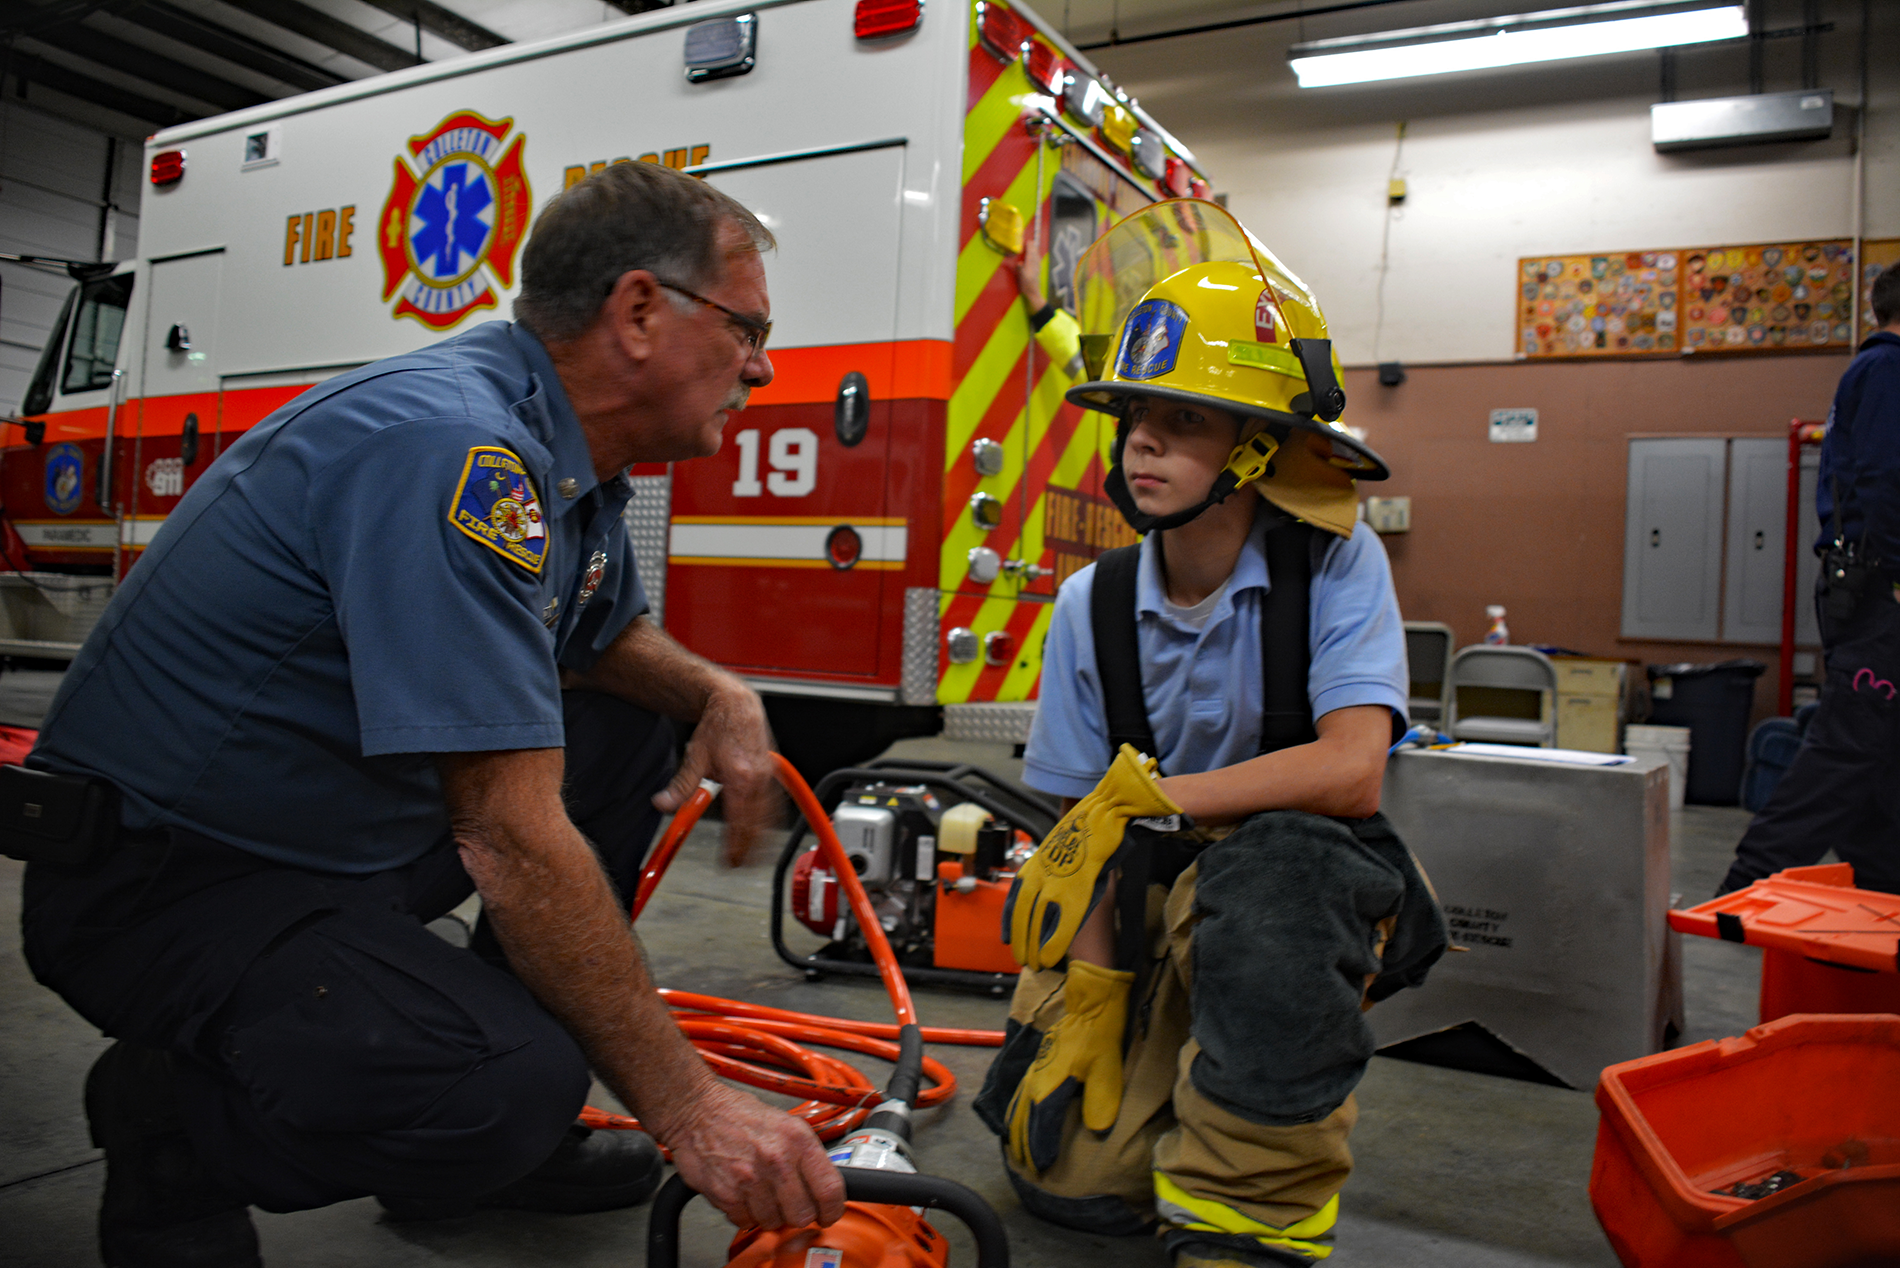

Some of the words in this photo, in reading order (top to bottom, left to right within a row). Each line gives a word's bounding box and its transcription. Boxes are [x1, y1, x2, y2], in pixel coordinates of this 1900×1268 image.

[424, 128, 492, 166] COLLETON
[565, 143, 710, 192] RUE
[283, 204, 356, 267] FIRE
[413, 278, 475, 311] COUNTY
[1131, 359, 1169, 375] RESCUE
[477, 454, 527, 475] COLLETON
[733, 428, 819, 497] 19
[152, 471, 183, 496] 911
[457, 509, 500, 541] FIRE
[506, 542, 541, 565] RESCUE
